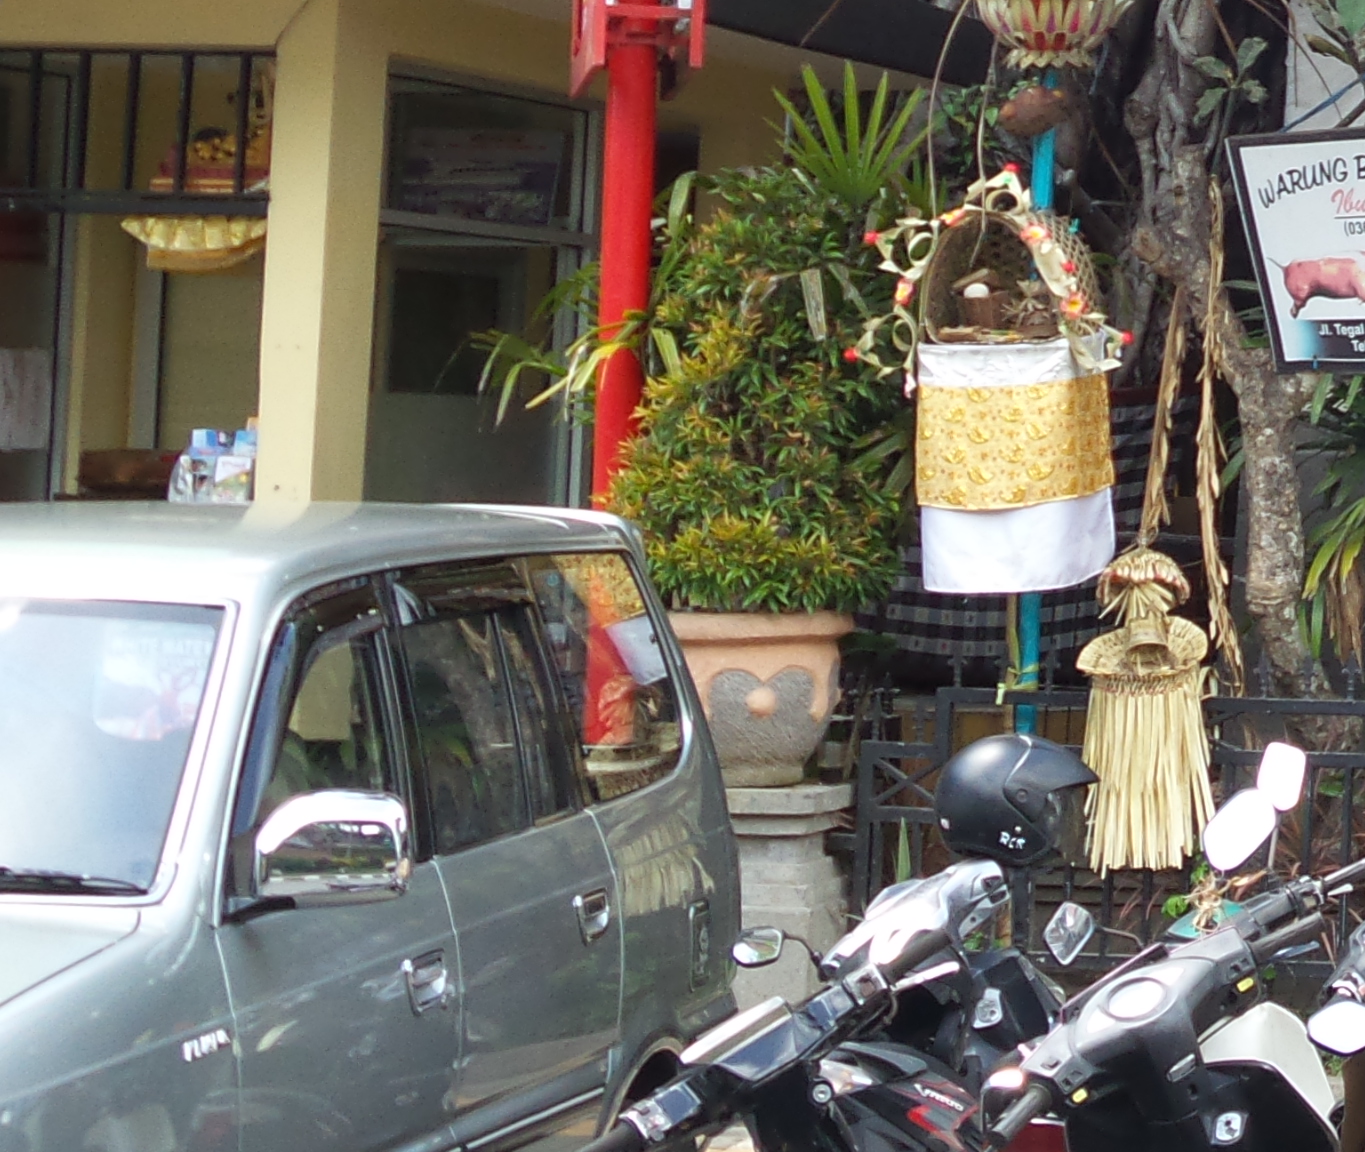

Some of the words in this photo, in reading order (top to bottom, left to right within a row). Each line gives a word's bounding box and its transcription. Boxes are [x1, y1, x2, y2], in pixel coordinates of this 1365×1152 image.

[1258, 157, 1349, 209] WARUNG
[1318, 323, 1333, 337] Jl.
[1334, 322, 1365, 338] Tegal
